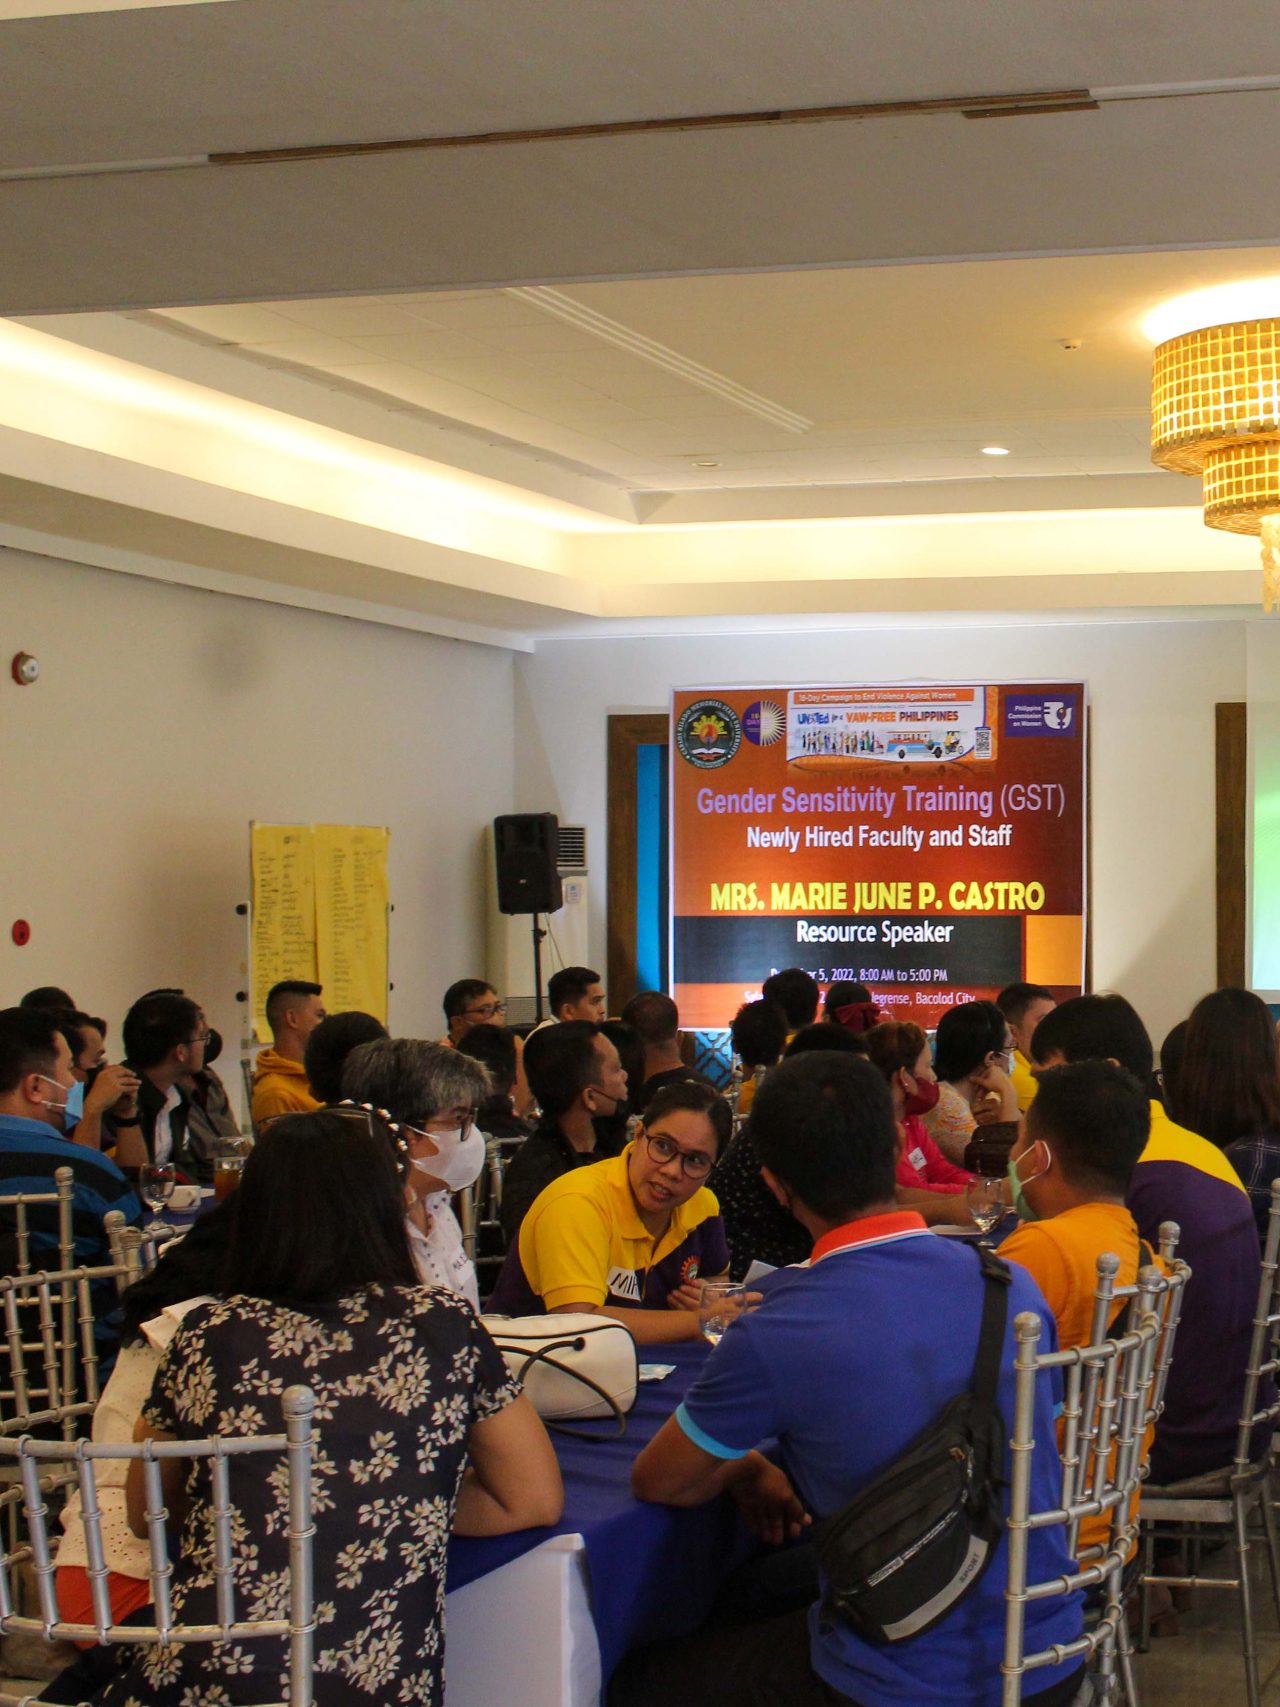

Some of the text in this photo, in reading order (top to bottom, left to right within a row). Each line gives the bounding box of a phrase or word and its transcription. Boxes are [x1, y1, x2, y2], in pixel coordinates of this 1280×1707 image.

[931, 691, 957, 699] Women
[846, 712, 896, 723] VAW-FREE
[899, 711, 959, 722] PHILIPPINES
[697, 783, 1065, 819] Gender Sensitivity Training (GST)
[747, 824, 1013, 853] Newly Hired Faculty and Staff
[710, 881, 1045, 914] MRS. MARIE JUNE P. CASTRO
[796, 919, 954, 948] Resource Speaker
[818, 968, 828, 983] 5,
[831, 968, 857, 983] 2022,
[860, 968, 879, 981] 8:00
[880, 968, 895, 981] AM
[897, 969, 908, 981] to
[909, 969, 931, 981] 5:00
[933, 969, 948, 981] PM
[915, 992, 954, 1004] Bacolod
